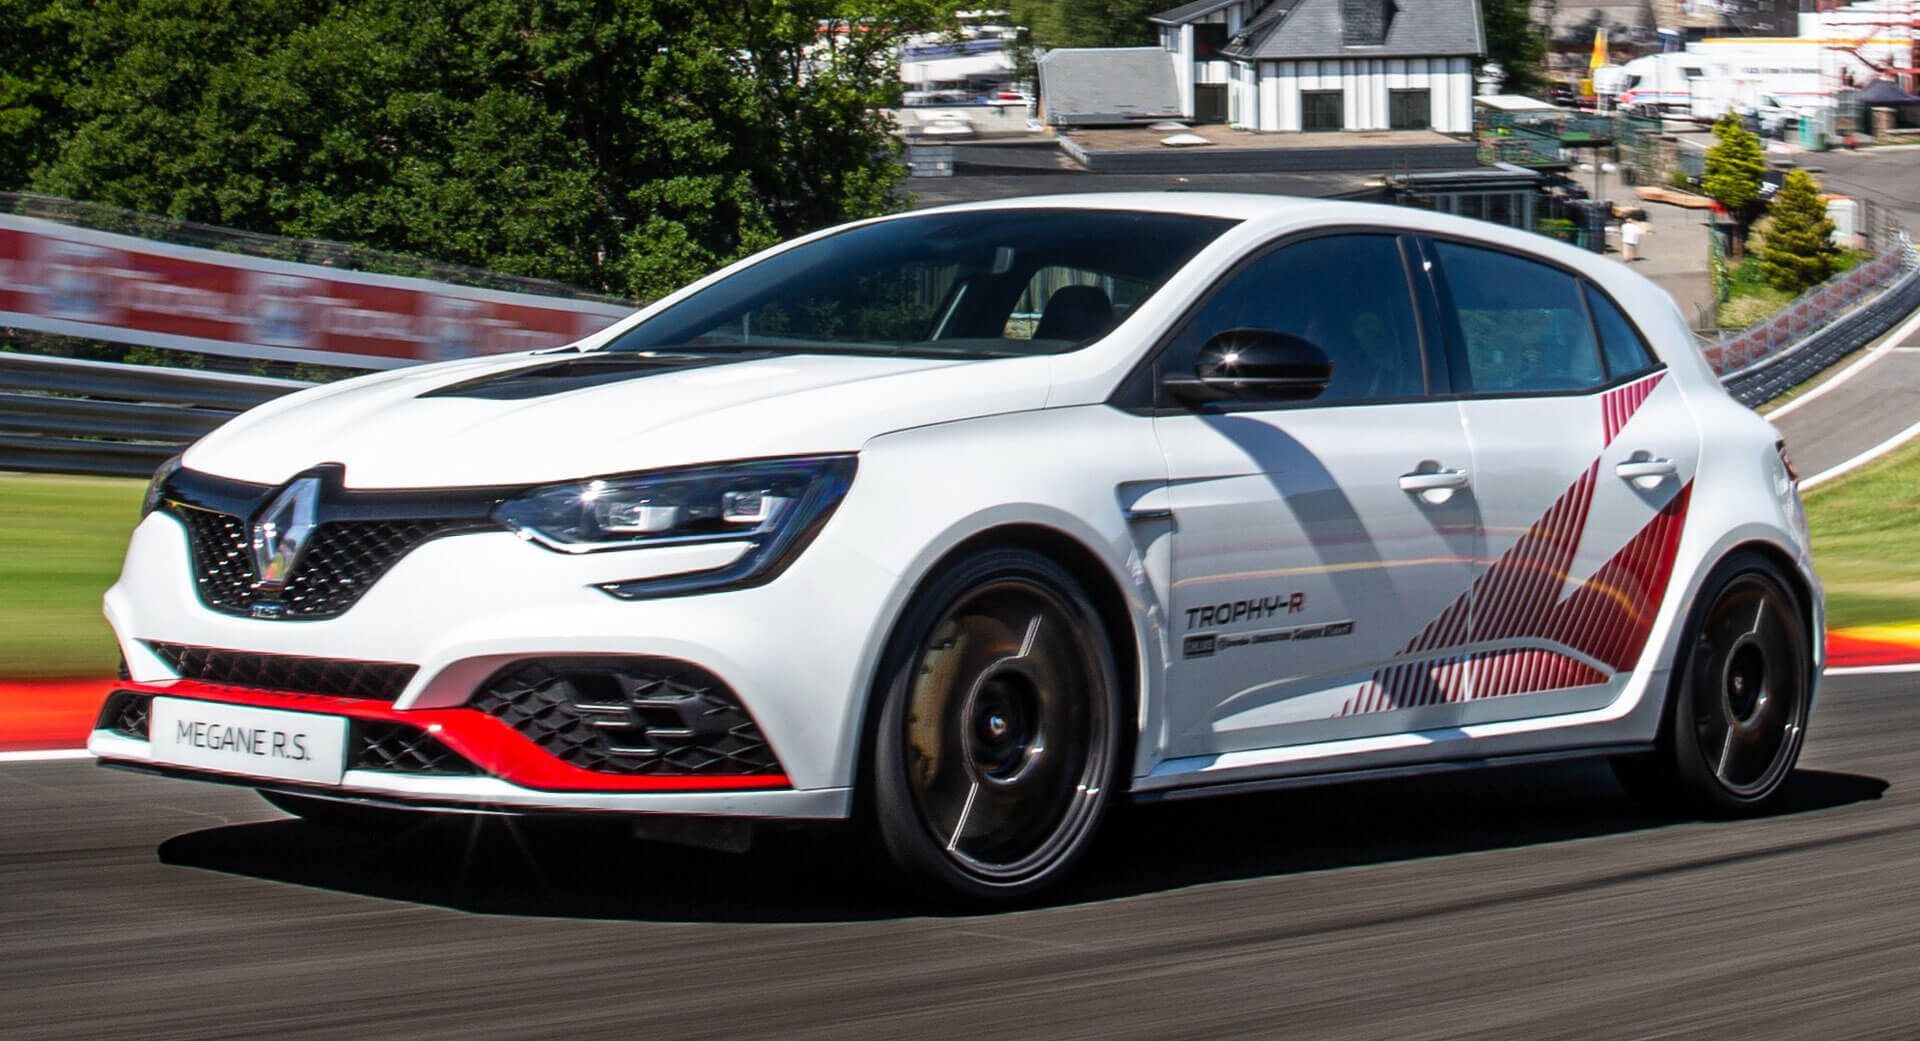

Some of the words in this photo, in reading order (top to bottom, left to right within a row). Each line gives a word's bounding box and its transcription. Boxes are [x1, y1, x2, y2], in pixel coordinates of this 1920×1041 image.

[1185, 591, 1305, 630] TROPHY-R
[176, 719, 266, 756] MEGANE
[272, 731, 312, 761] R.S.
